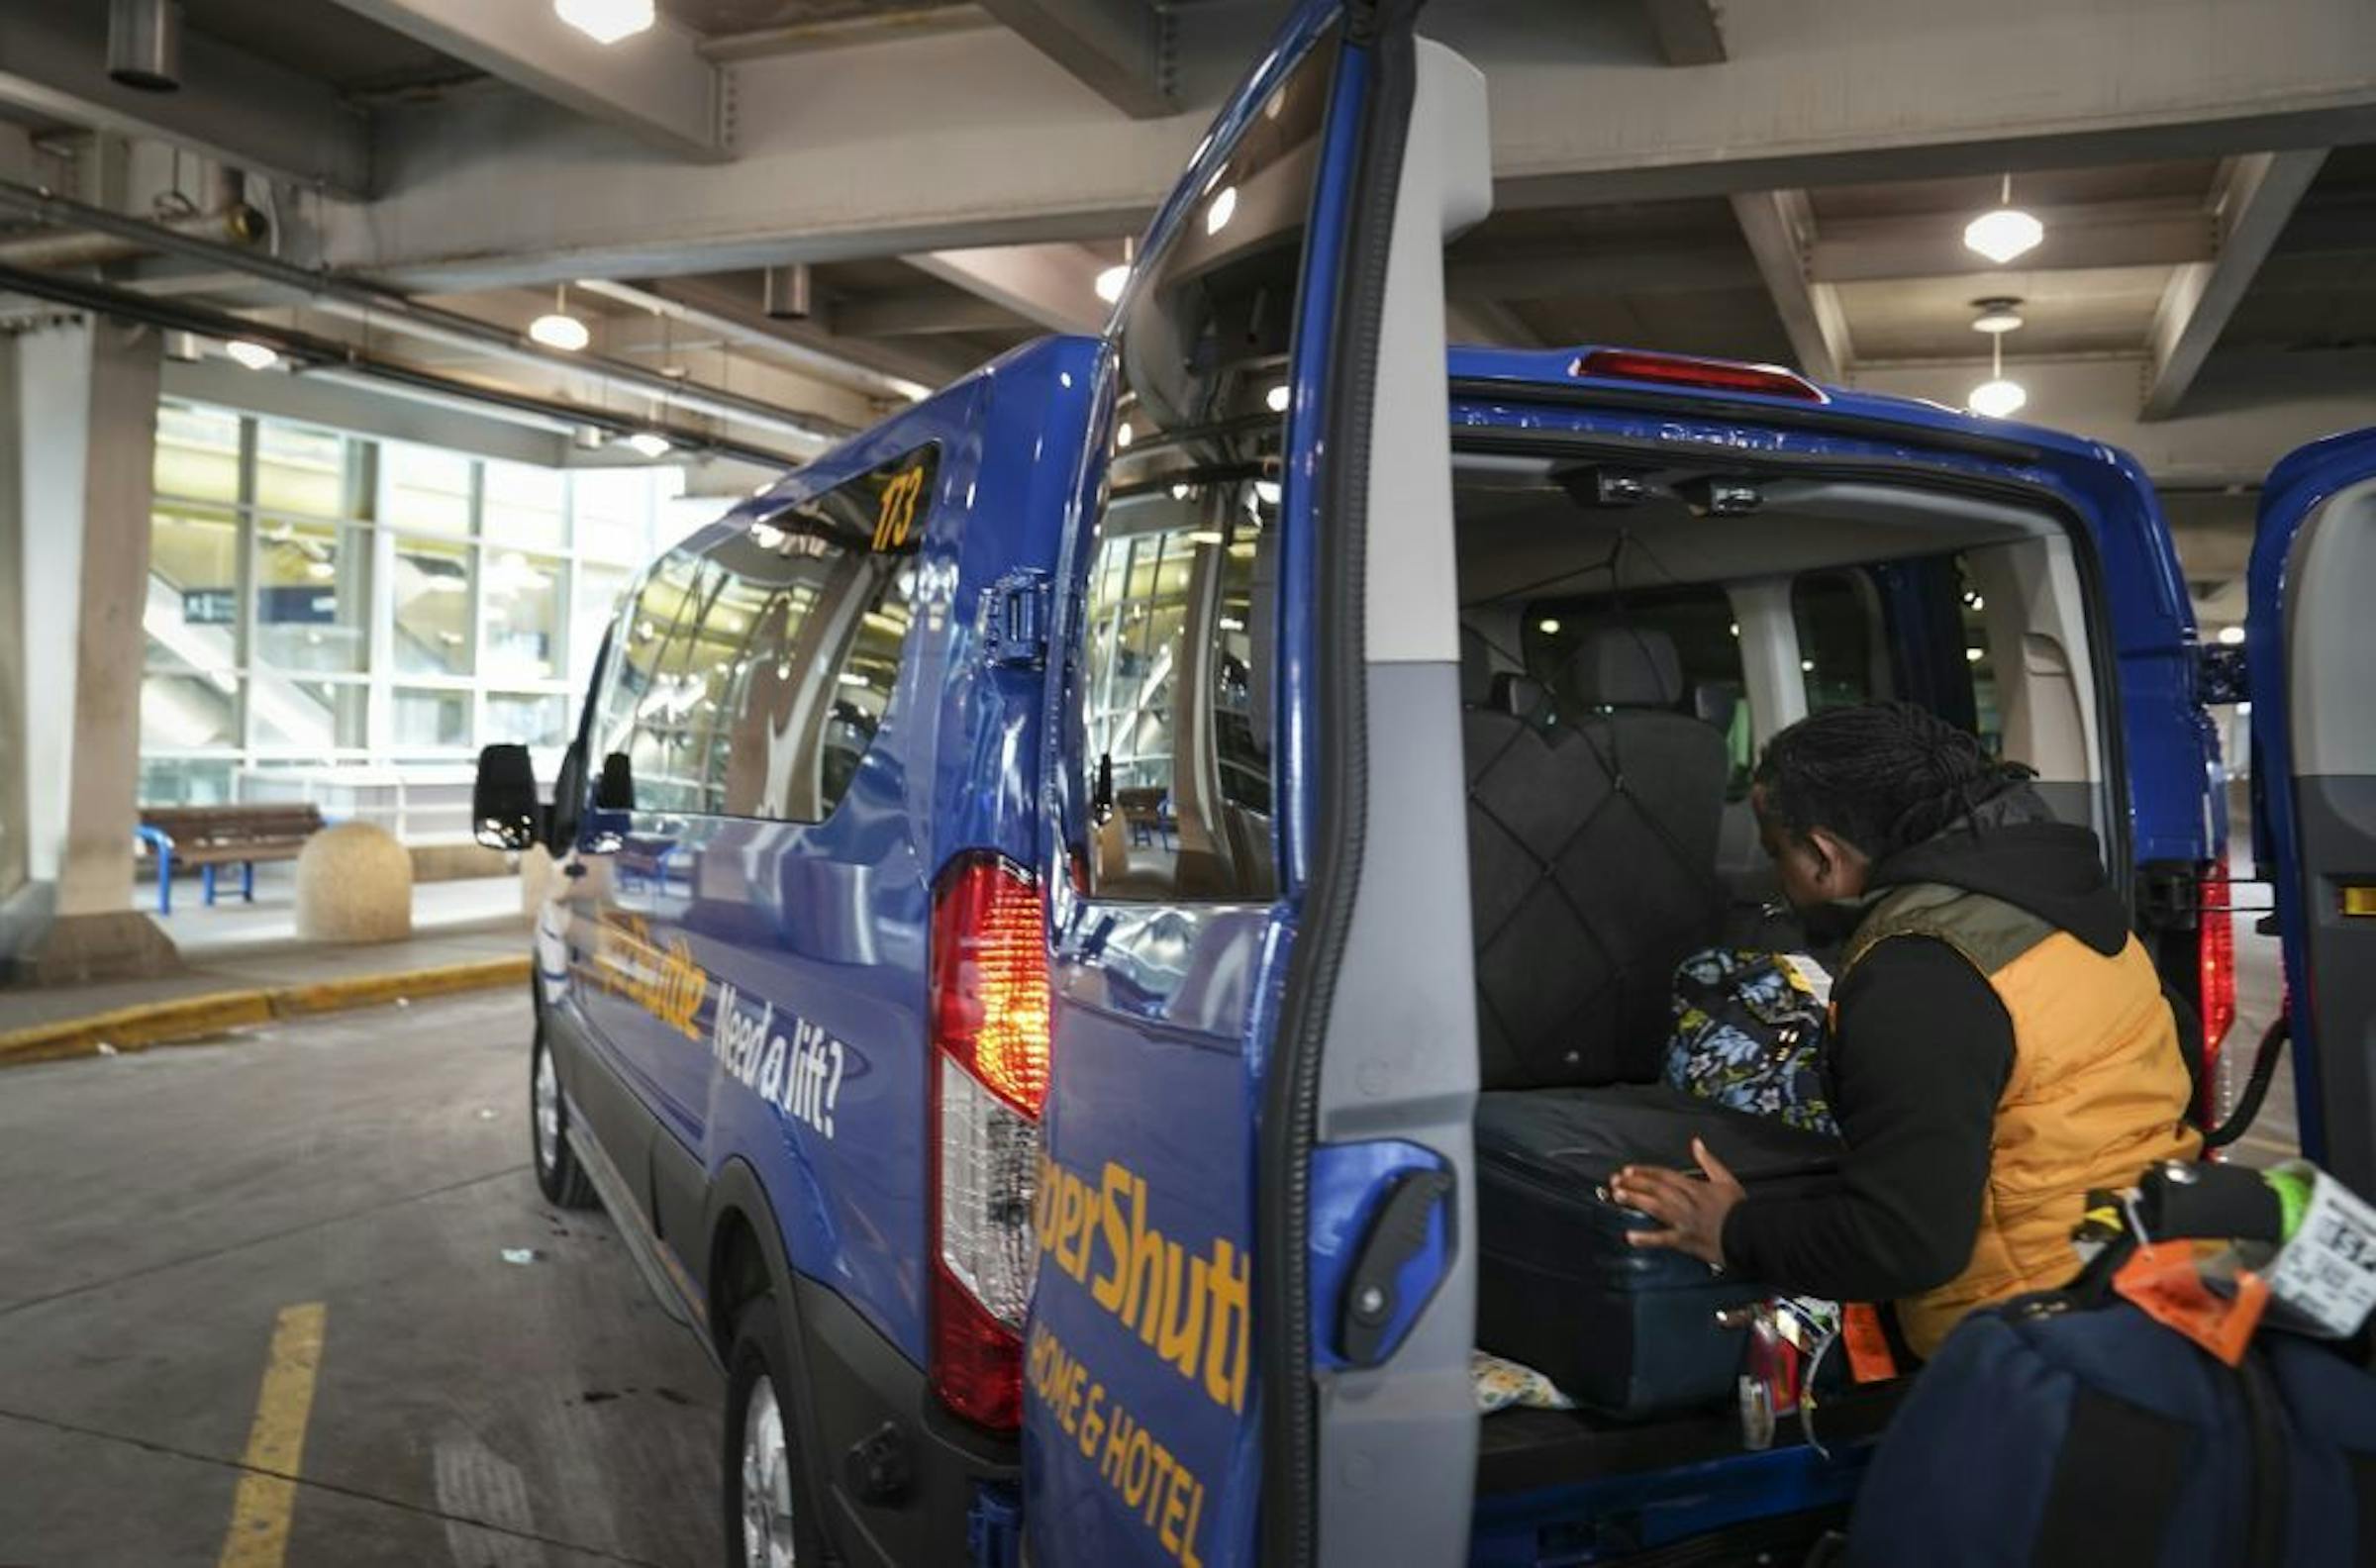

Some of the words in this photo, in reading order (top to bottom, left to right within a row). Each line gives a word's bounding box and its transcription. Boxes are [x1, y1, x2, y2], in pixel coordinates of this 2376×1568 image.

[713, 982, 772, 1089] Need
[759, 1035, 787, 1103] a
[784, 1017, 843, 1138] lift?
[1026, 1320, 1088, 1435] HOME
[1079, 1384, 1106, 1457] &
[1101, 1404, 1204, 1568] HOTEL
